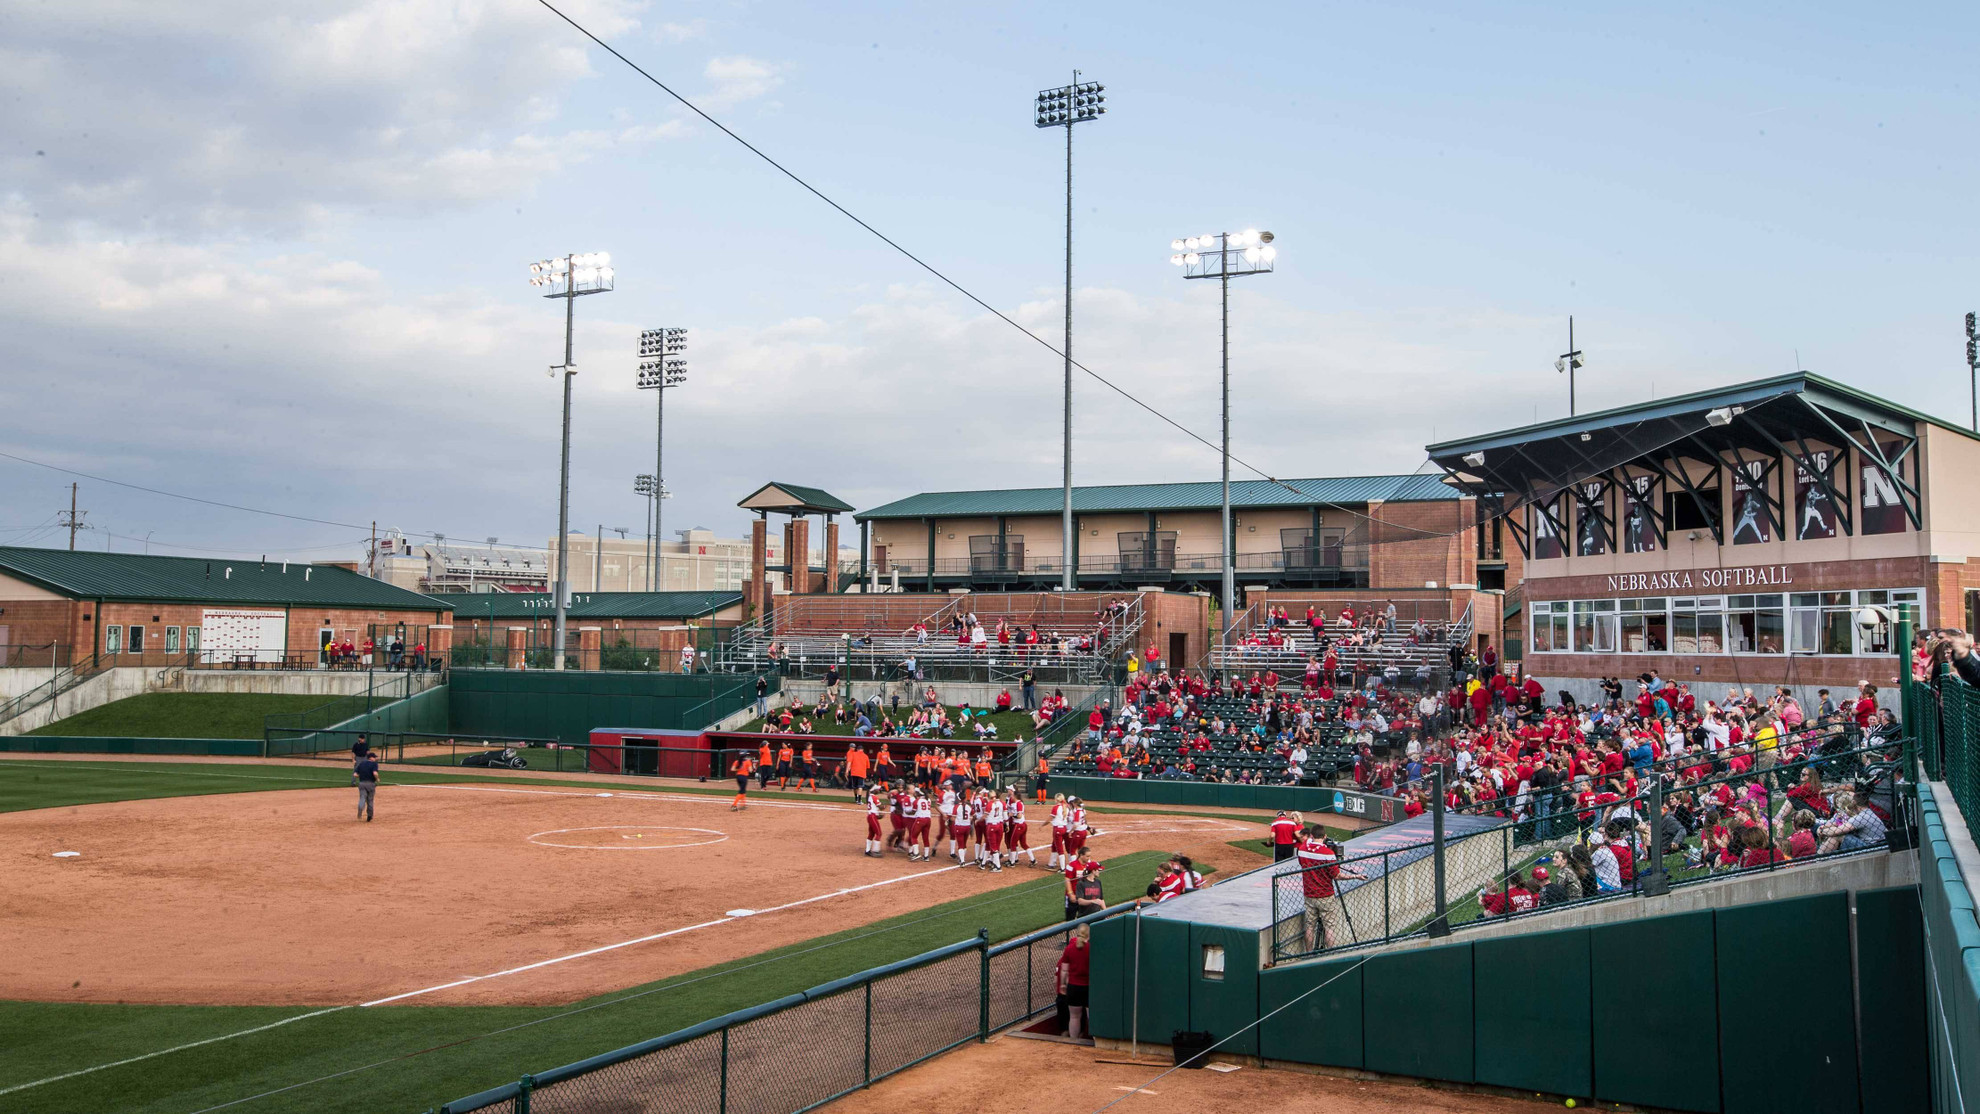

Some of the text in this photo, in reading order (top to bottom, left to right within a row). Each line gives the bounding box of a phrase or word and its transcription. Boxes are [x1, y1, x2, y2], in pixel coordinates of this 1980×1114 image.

[1862, 464, 1901, 508] N
[698, 546, 706, 554] N
[767, 549, 774, 558] N
[1607, 566, 1793, 592] NEBRASKA SOFTBALL
[1381, 800, 1394, 822] N
